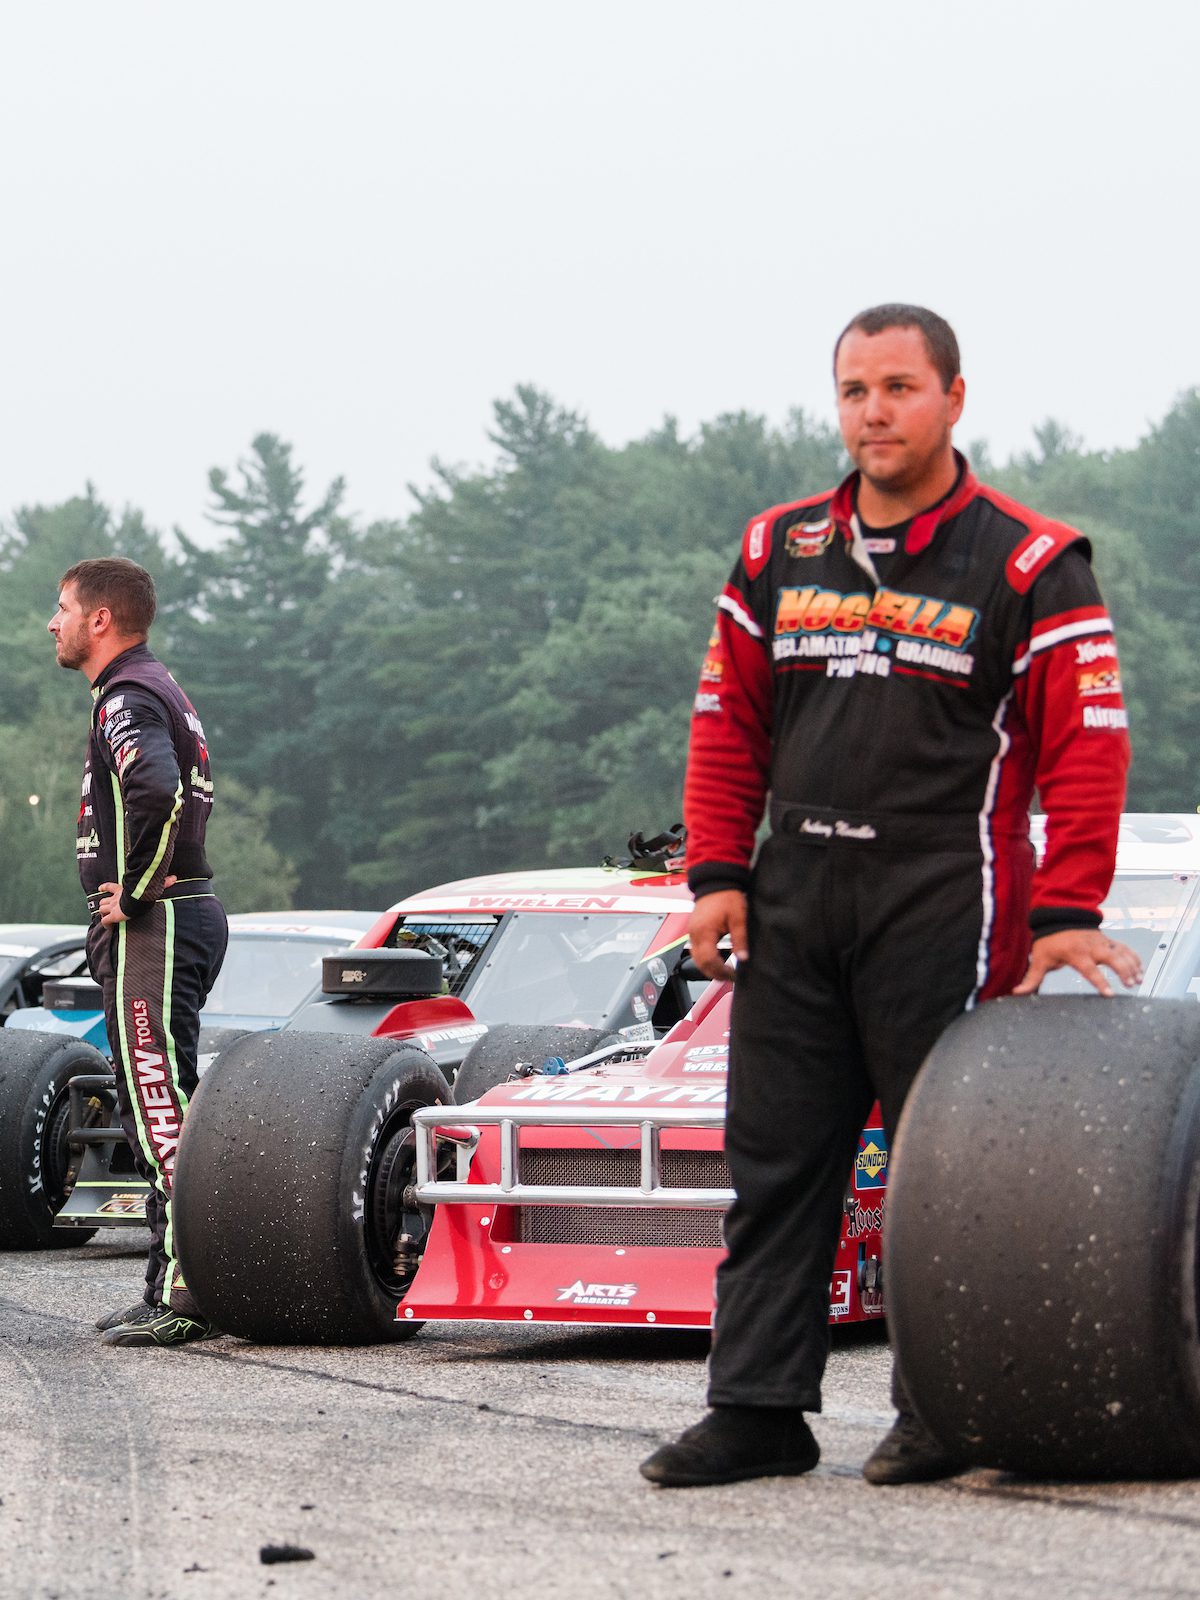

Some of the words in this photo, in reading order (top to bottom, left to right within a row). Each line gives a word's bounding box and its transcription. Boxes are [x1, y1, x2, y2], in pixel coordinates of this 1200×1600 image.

[775, 587, 977, 647] NOCELLA
[825, 652, 891, 678] PAVING
[895, 638, 974, 675] GRADING
[468, 897, 621, 909] WHELEN
[134, 1001, 147, 1046] TOOLS
[857, 1151, 886, 1168] SUNOCO
[573, 1297, 629, 1305] RADIATOR
